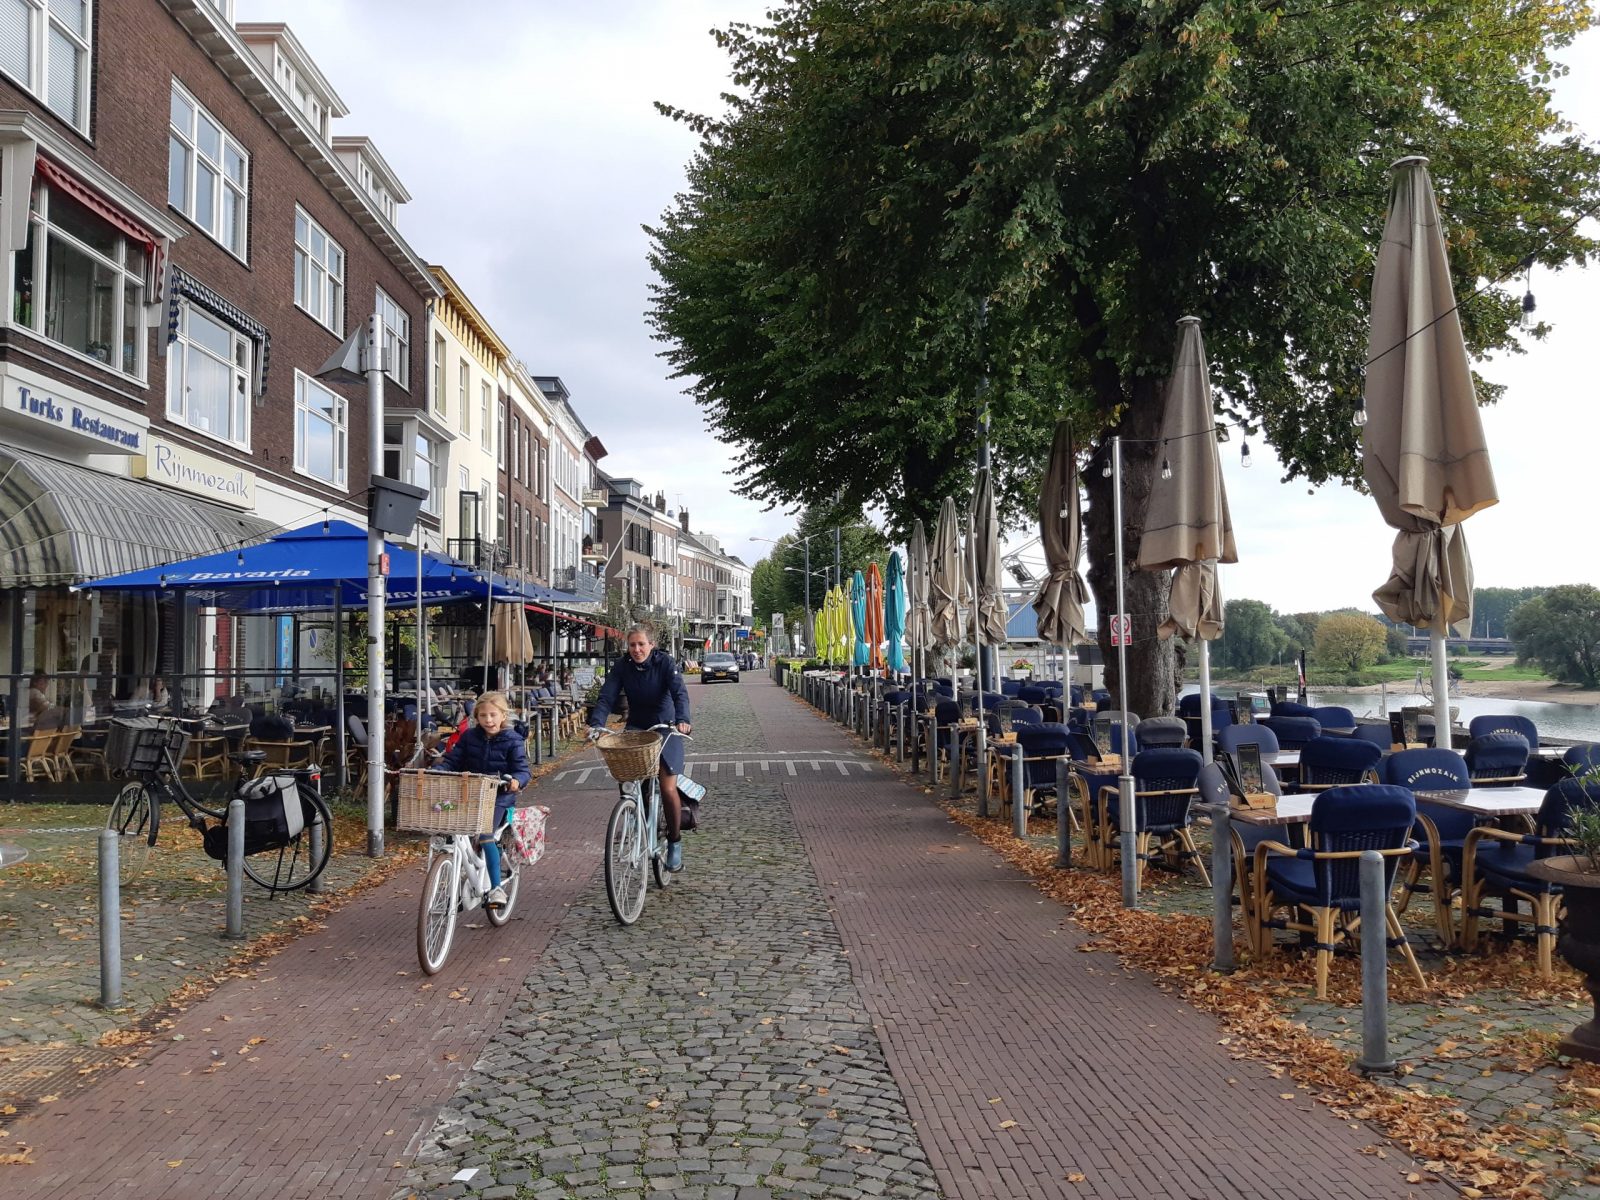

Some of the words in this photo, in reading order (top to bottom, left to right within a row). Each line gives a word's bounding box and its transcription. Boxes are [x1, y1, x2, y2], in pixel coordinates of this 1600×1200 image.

[18, 386, 64, 423] Turks
[71, 406, 140, 449] Restaurant
[154, 443, 250, 500] Rijnmozaik
[188, 569, 311, 581] Bavaria
[1407, 767, 1459, 785] RIJNMOZAIK
